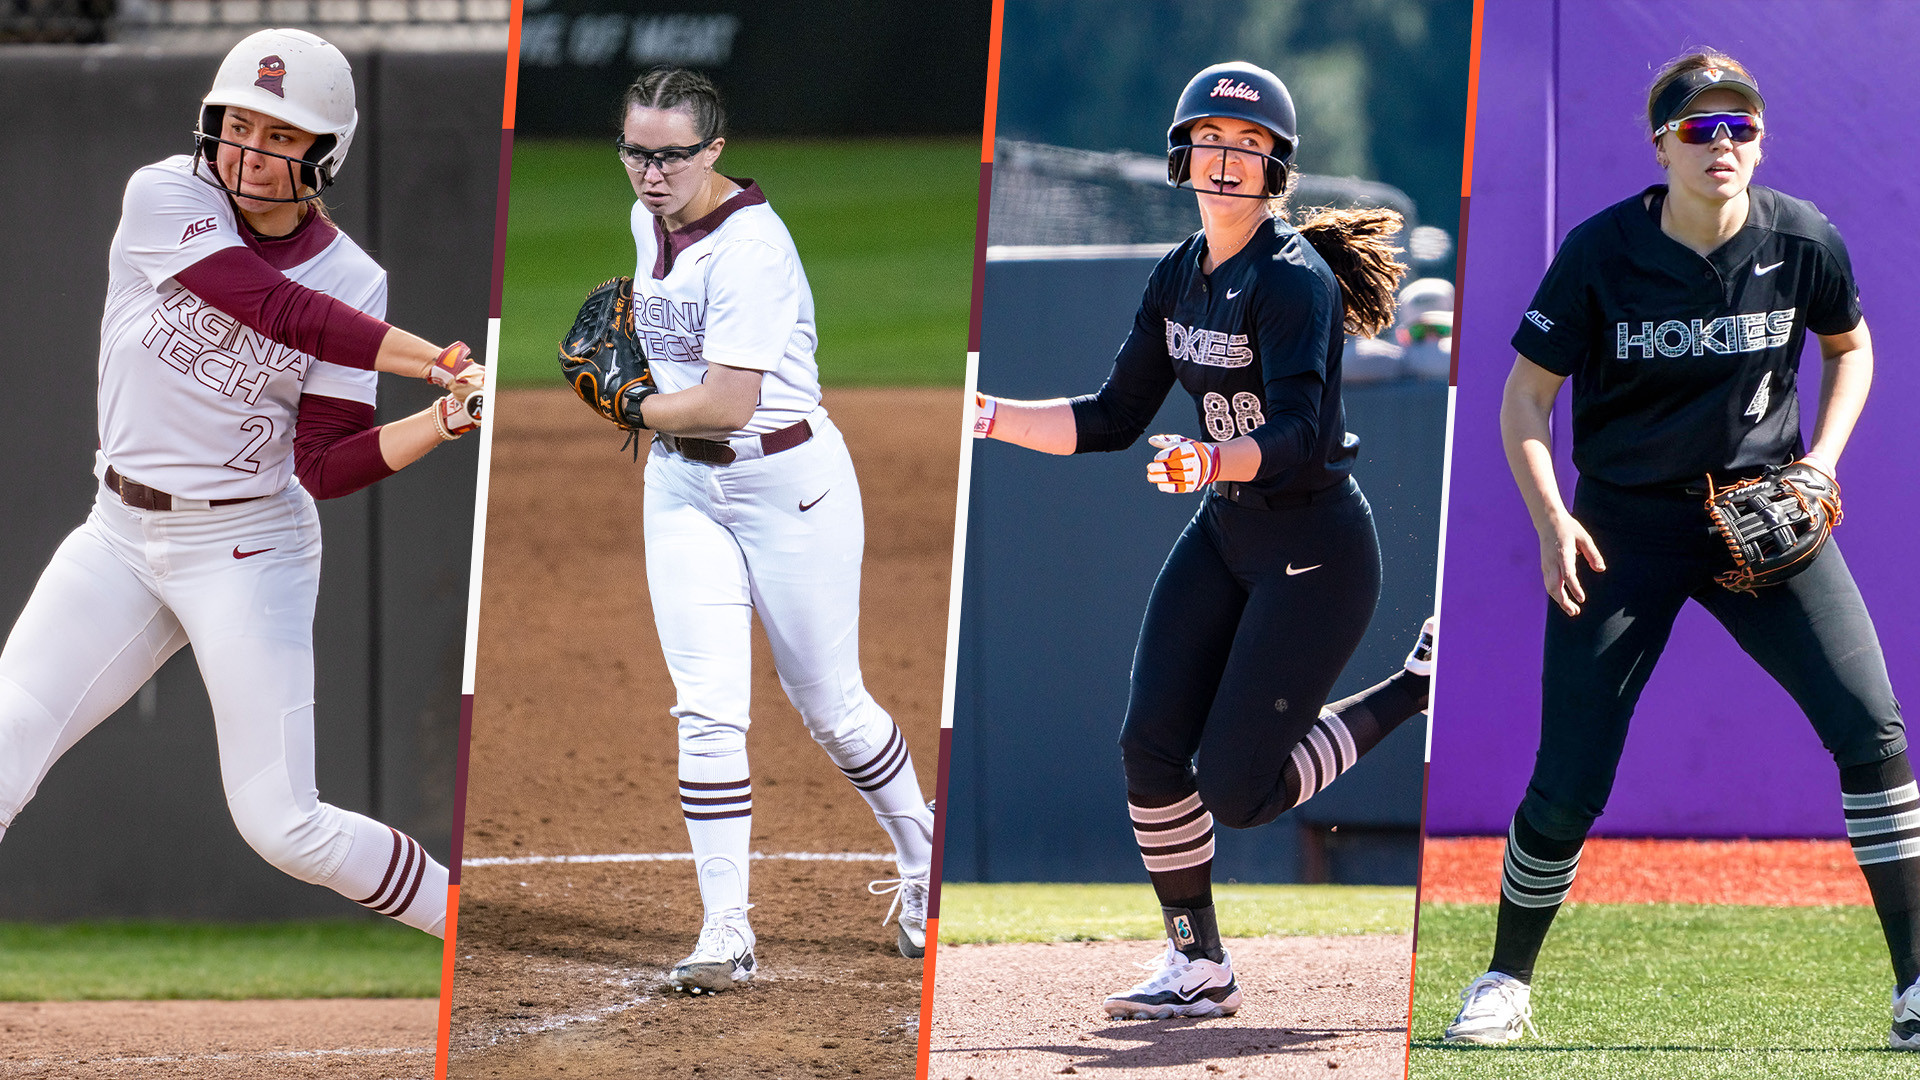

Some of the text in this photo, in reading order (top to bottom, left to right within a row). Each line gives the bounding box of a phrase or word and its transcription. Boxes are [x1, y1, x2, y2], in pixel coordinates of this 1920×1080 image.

[1210, 78, 1260, 102] Hokies
[181, 216, 217, 241] ACC
[163, 286, 309, 381] RGINIA
[1524, 309, 1555, 333] ACC
[1617, 307, 1796, 359] HOKIES
[142, 309, 270, 406] TECH
[1203, 391, 1266, 442] 88
[1744, 371, 1772, 423] 4
[223, 415, 274, 474] 2
